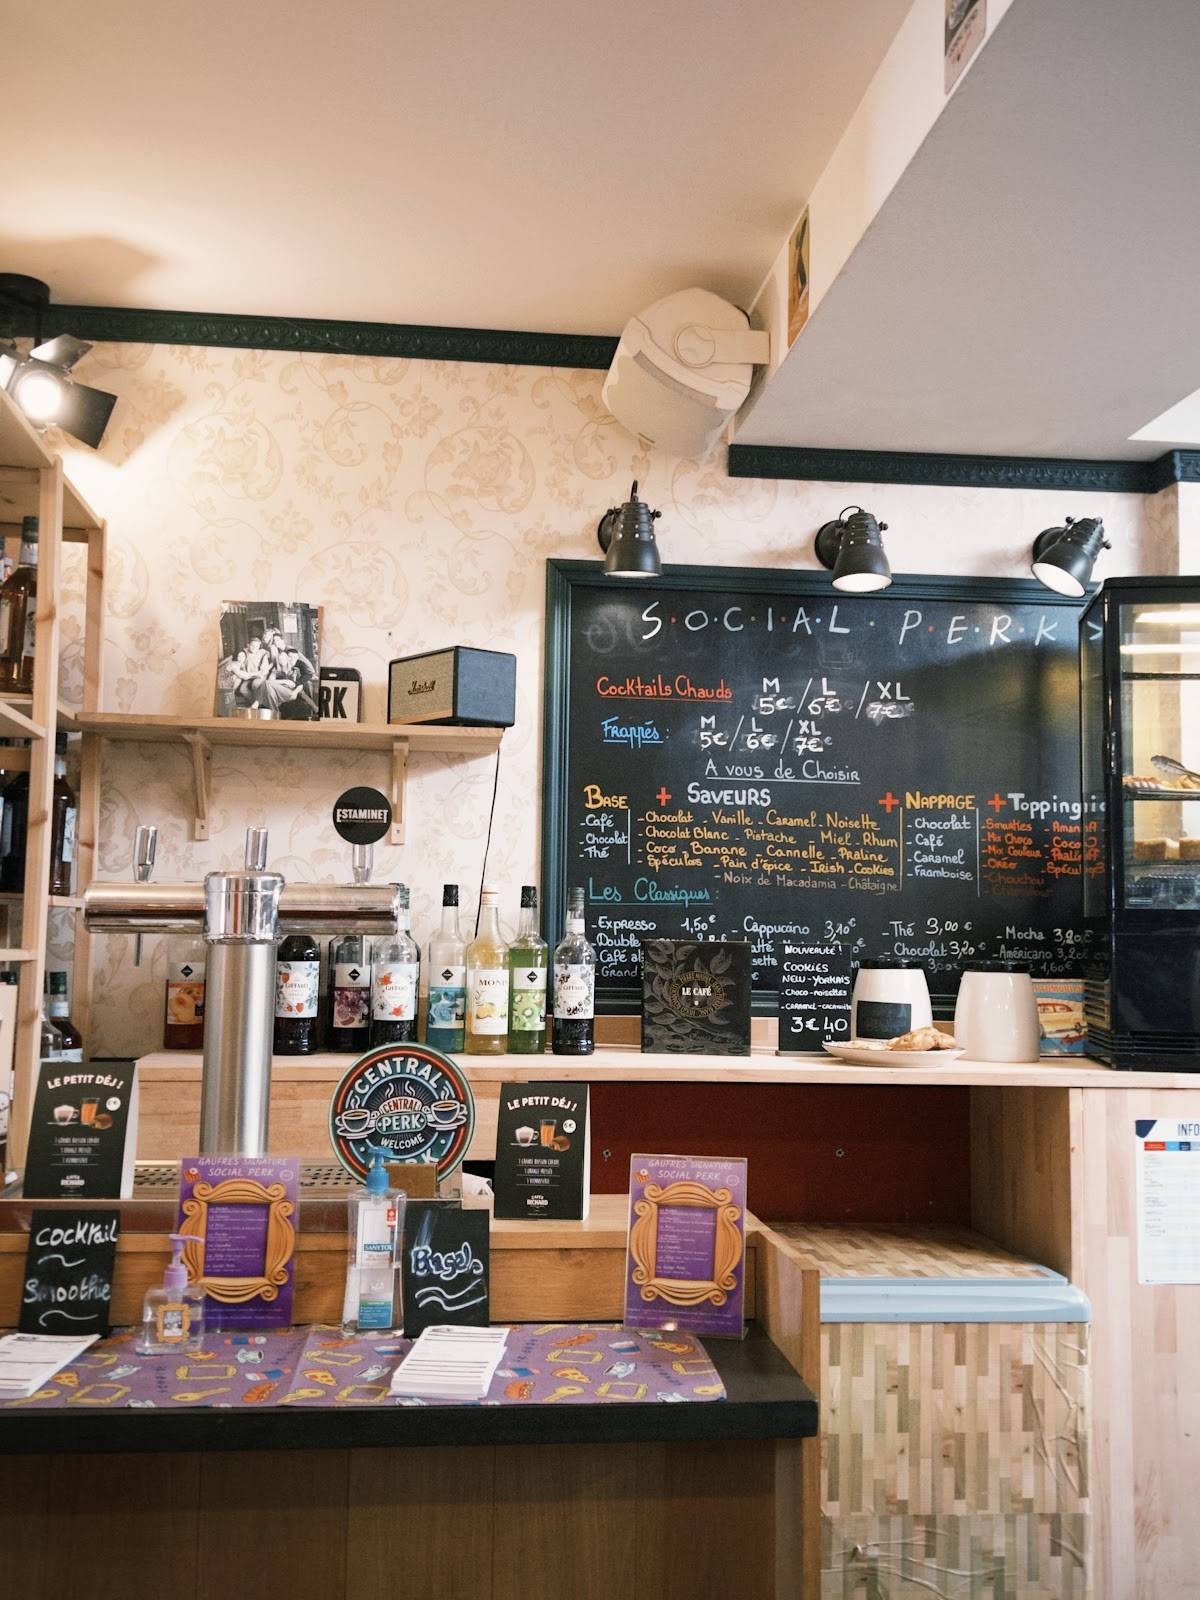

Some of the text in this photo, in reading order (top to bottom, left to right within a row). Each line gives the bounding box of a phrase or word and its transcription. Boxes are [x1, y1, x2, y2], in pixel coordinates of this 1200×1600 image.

[675, 675, 732, 700] Chauds
[763, 677, 780, 693] M
[822, 677, 837, 696] L
[877, 681, 911, 701] XL
[601, 716, 661, 748] Frappés
[700, 714, 716, 729] M
[752, 716, 763, 733] L
[798, 719, 822, 736] XL
[725, 764, 764, 779] vous
[774, 758, 796, 779] de
[802, 759, 861, 781] Choisir
[905, 790, 976, 810] NAPPAGE
[336, 808, 389, 824] ESTAMINET
[585, 812, 615, 832] Café
[645, 808, 881, 831] Chocolat Vanille Caramel Noisette
[914, 813, 971, 831] Chocolat
[585, 830, 629, 845] Chocolat
[645, 825, 899, 848] Chocolat Blanc Pistache Miel Rhum
[914, 833, 944, 851] Café
[584, 845, 610, 859] Thé
[646, 841, 678, 855] Coco
[689, 841, 748, 857] Banane
[766, 843, 826, 860] Cannelle
[913, 849, 965, 865] Caramel
[720, 854, 748, 870] Pain
[810, 859, 845, 875] Irish
[914, 866, 974, 881] Framboise
[723, 871, 753, 885] Noix
[757, 875, 772, 887] de
[776, 874, 837, 890] Macadamia
[588, 876, 622, 901] Les
[633, 876, 710, 909] Classiques
[598, 915, 657, 936] Expresso
[889, 920, 915, 938] Thé
[1005, 925, 1046, 941] Mocha
[596, 932, 641, 948] Double
[893, 940, 948, 958] Chocolat
[599, 948, 628, 967] Café
[601, 965, 639, 978] Grand
[681, 985, 712, 996] LE CAFÉ
[47, 1077, 62, 1090] LE
[63, 1074, 95, 1086] PETIT
[95, 1074, 118, 1090] DÉJ
[353, 1056, 442, 1094] CENTRAL
[382, 1097, 419, 1113] CENTRAL
[506, 1098, 522, 1111] LE
[522, 1096, 550, 1107] PETIT
[551, 1096, 572, 1110] DÉJ
[381, 1115, 421, 1132] PERK
[380, 1133, 425, 1150] WELCOME
[208, 1167, 275, 1178] SOCIAL PERK
[657, 1169, 722, 1181] SOCIAL PERK
